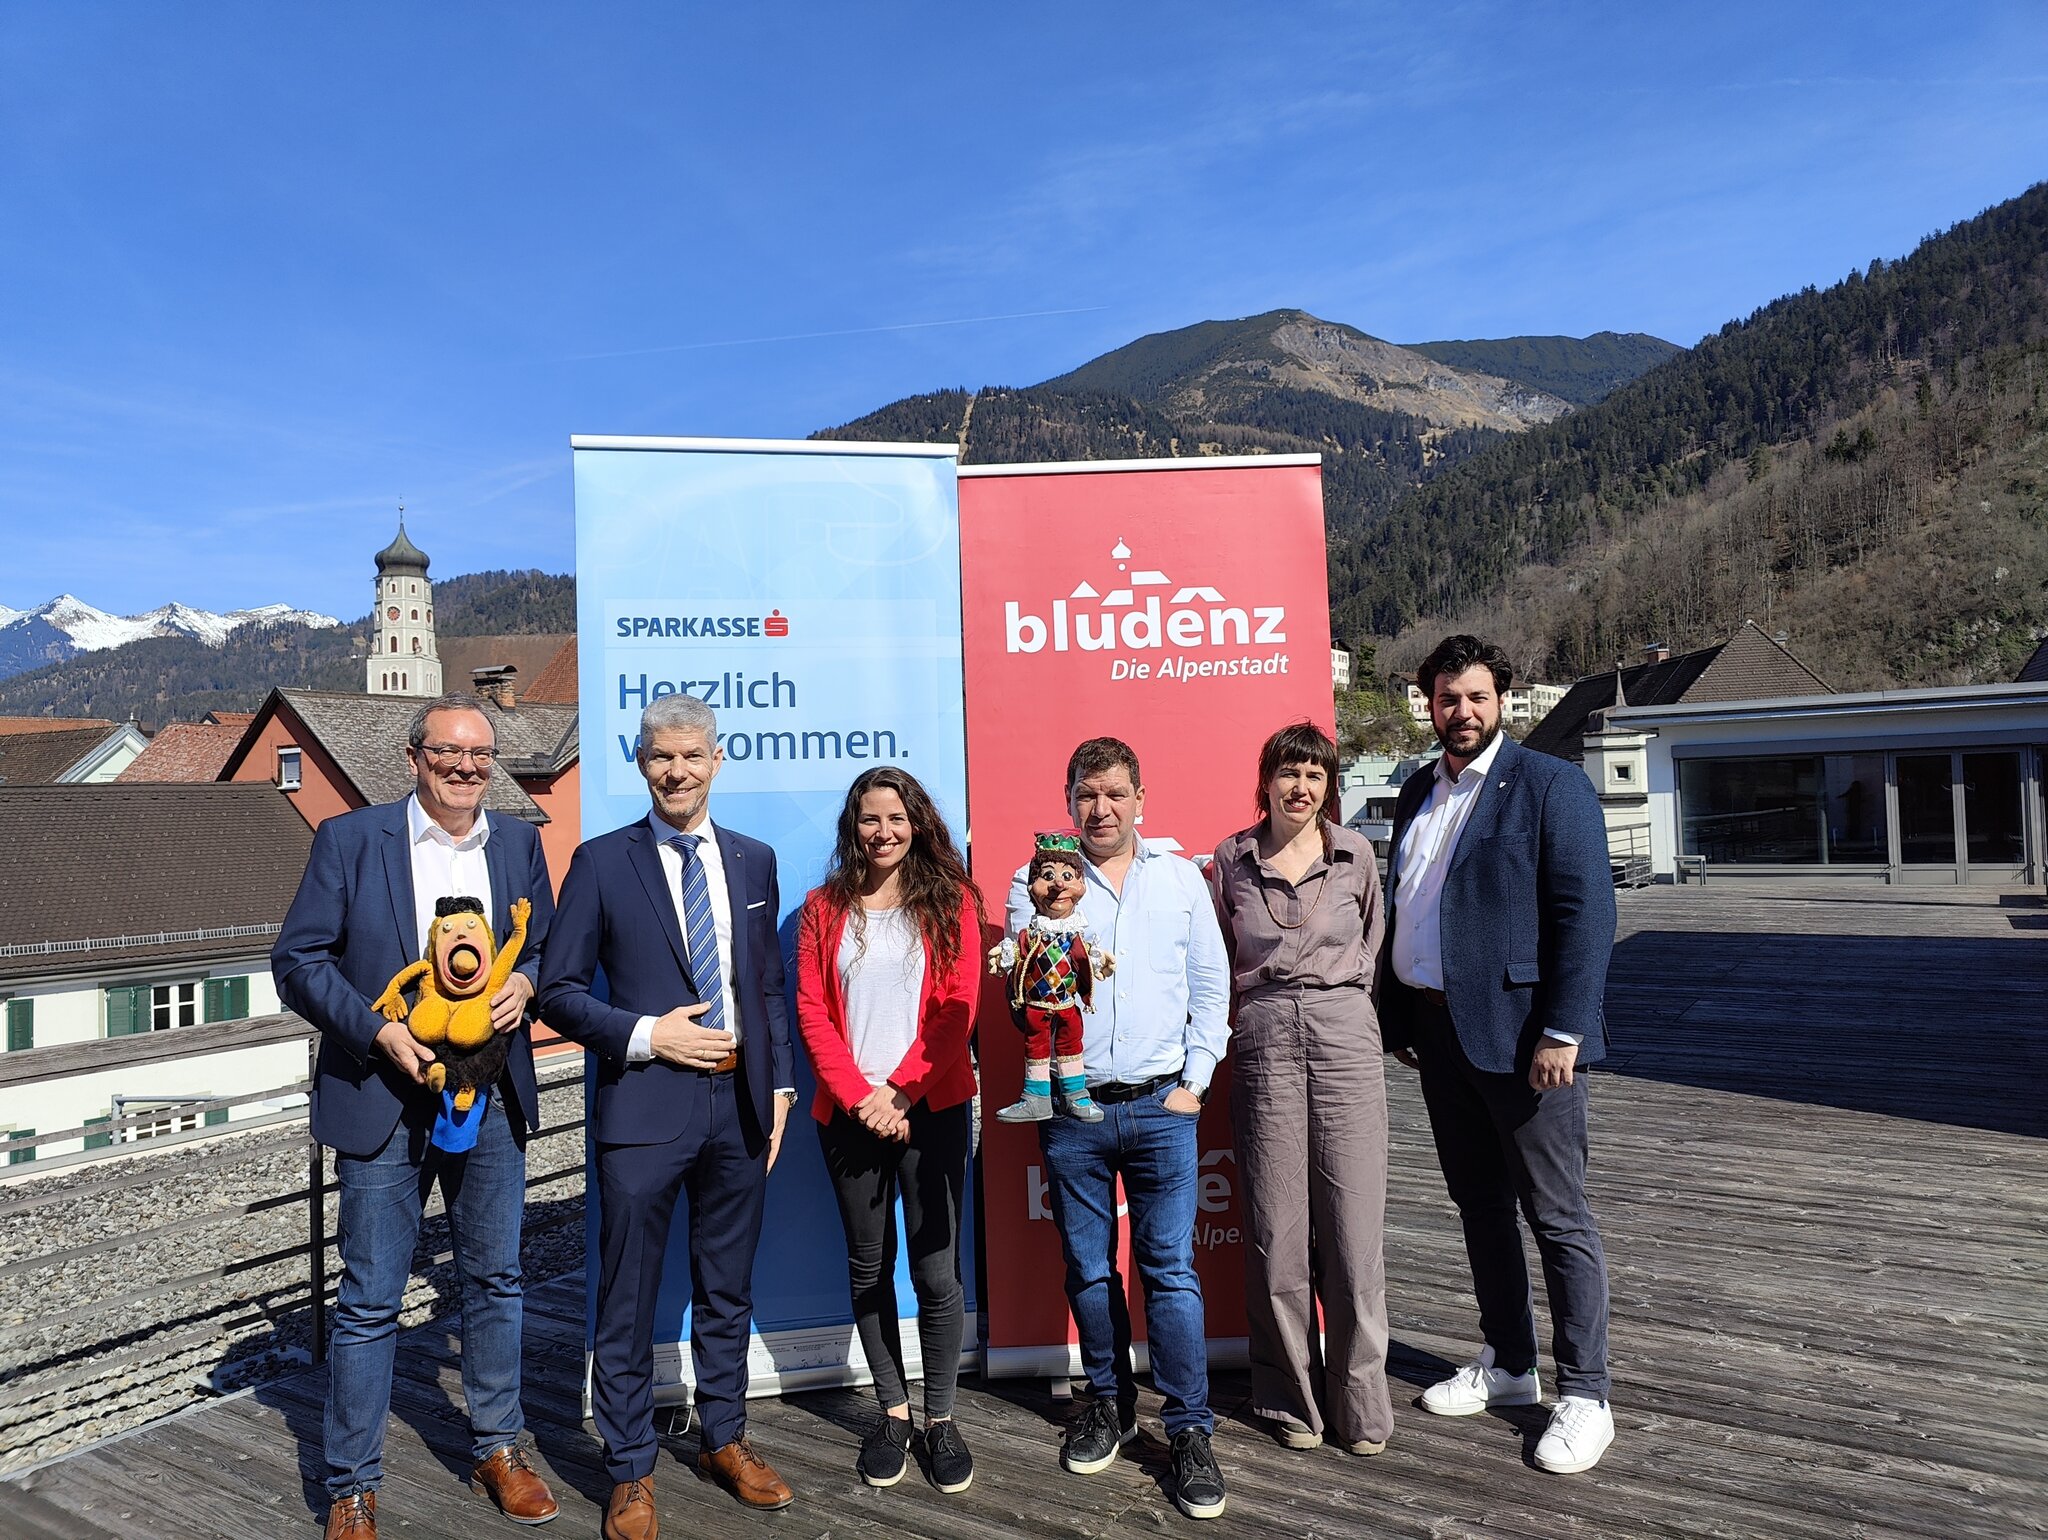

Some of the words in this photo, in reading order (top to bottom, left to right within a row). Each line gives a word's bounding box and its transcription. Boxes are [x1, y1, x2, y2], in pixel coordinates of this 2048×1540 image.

[616, 616, 760, 638] SPARKASSE
[1004, 595, 1287, 654] bludenz
[1110, 658, 1151, 681] Die
[1156, 652, 1290, 683] Alpenstadt
[617, 728, 910, 763] ommen.
